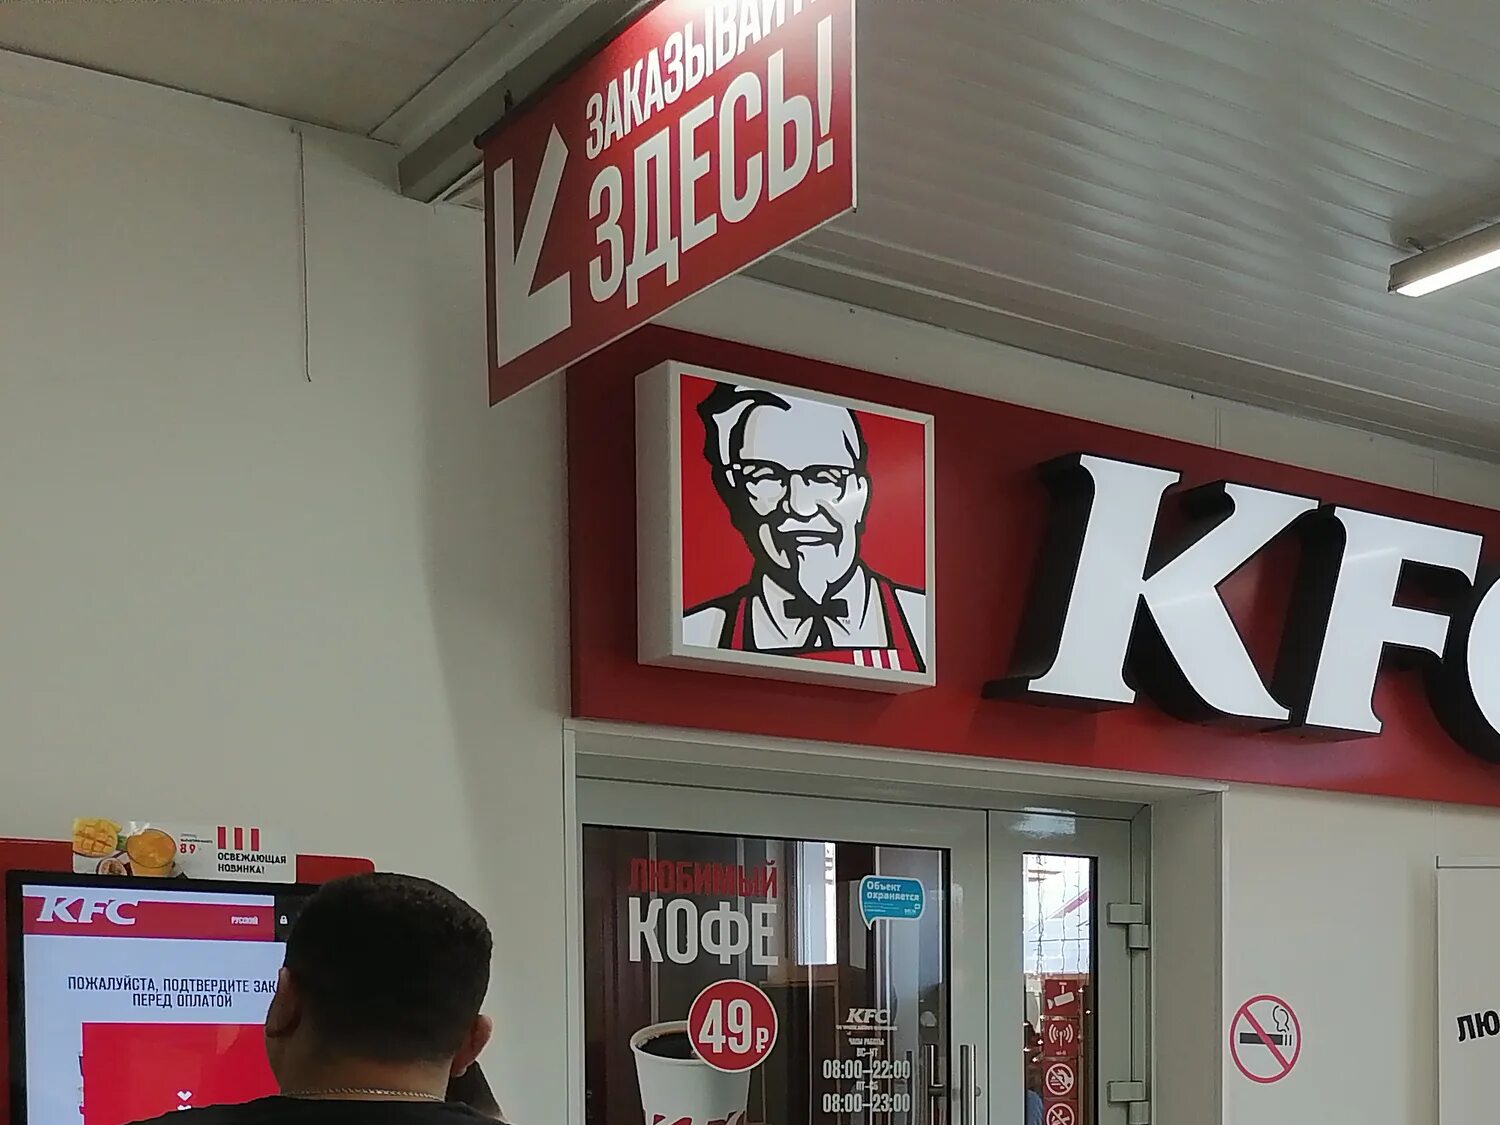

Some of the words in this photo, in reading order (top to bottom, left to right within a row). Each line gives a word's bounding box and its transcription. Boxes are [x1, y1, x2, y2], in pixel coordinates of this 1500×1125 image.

[588, 14, 834, 310] ЗДЕСЬ!
[218, 853, 287, 864] ОСВЕЖАЮЩАЯ
[218, 864, 265, 874] НОВИНКА!
[627, 858, 778, 898] ЛЮБИМЫЙ
[867, 881, 902, 892] Объект
[867, 892, 920, 902] охраняется
[36, 895, 140, 926] KFC
[628, 898, 779, 966] КОФЕ
[68, 976, 159, 992] ПОЖАЛУЙСТА,
[164, 979, 250, 994] ПОДТВЕРДИТЕ
[253, 981, 278, 994] ЗАК
[132, 994, 173, 1009] ПЕРЕД
[177, 993, 233, 1008] ОПЛАТОЙ
[846, 1008, 889, 1024] KFC
